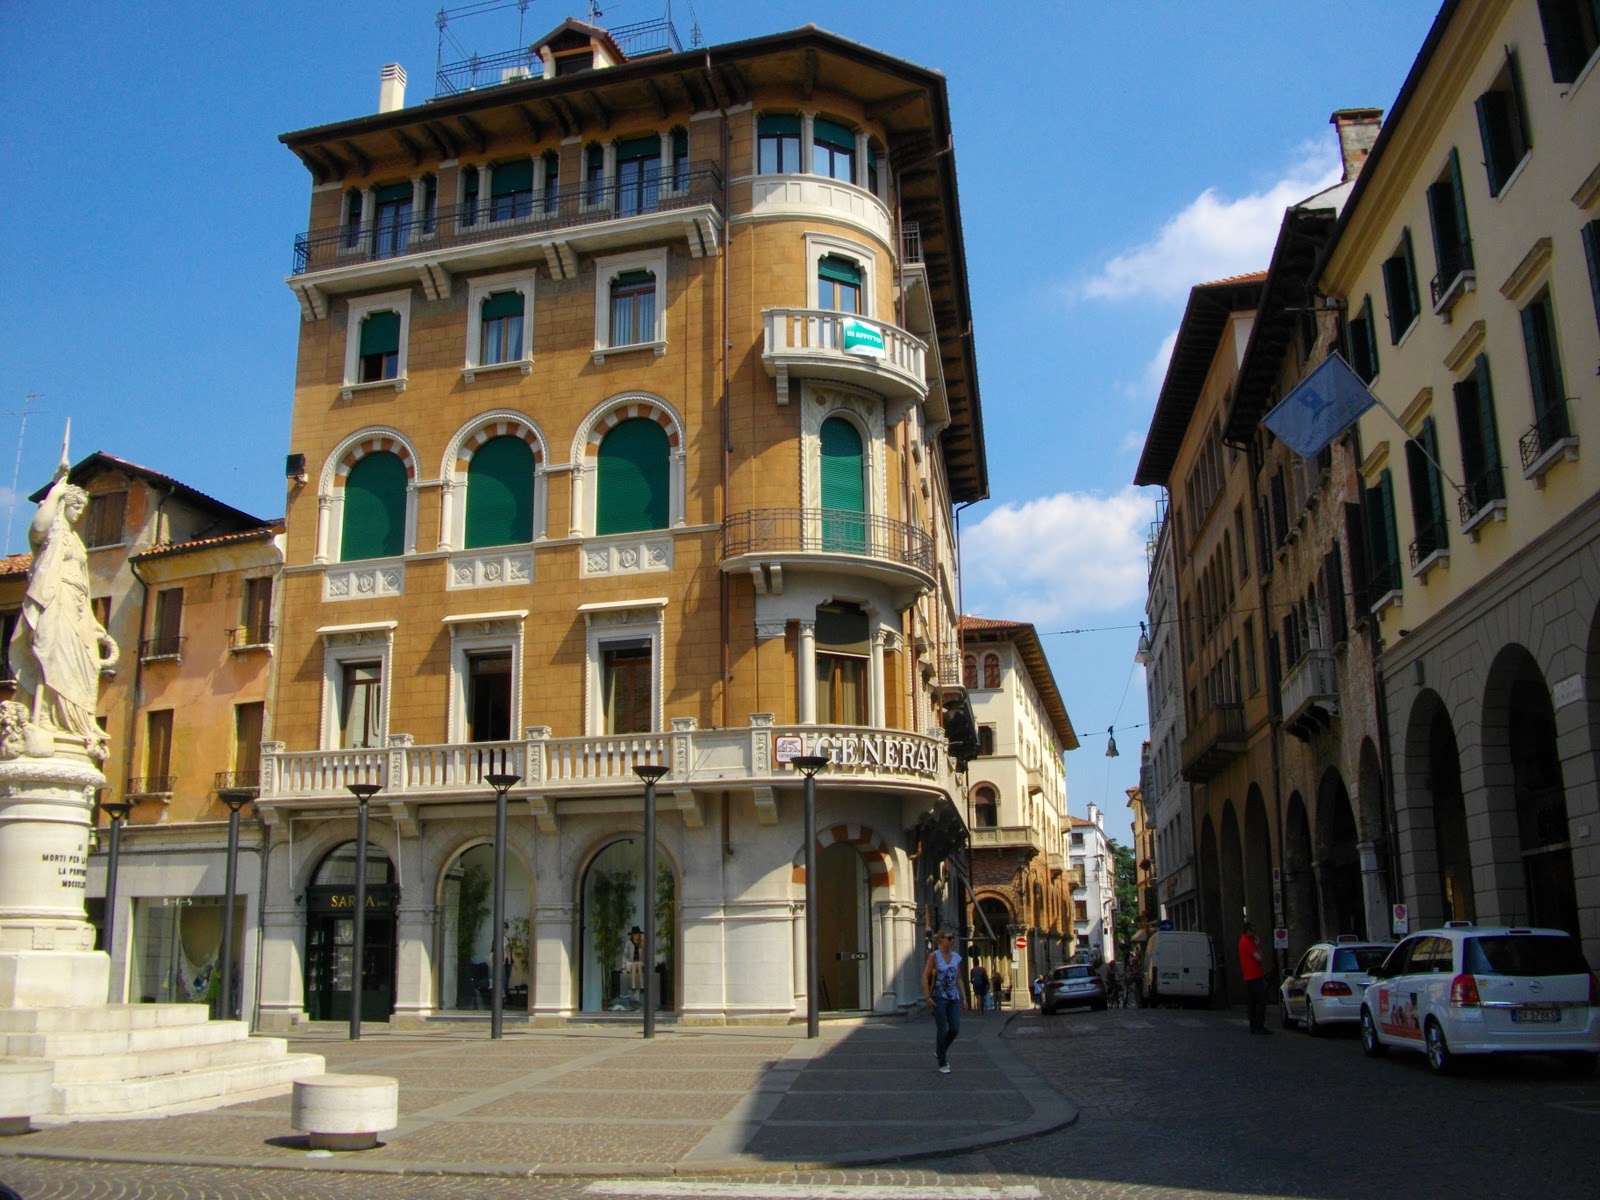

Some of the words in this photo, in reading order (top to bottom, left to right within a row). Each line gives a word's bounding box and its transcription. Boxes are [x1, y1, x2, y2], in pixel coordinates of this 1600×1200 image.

[42, 854, 66, 862] MORTI
[69, 856, 79, 864] PER
[58, 867, 66, 875] LA
